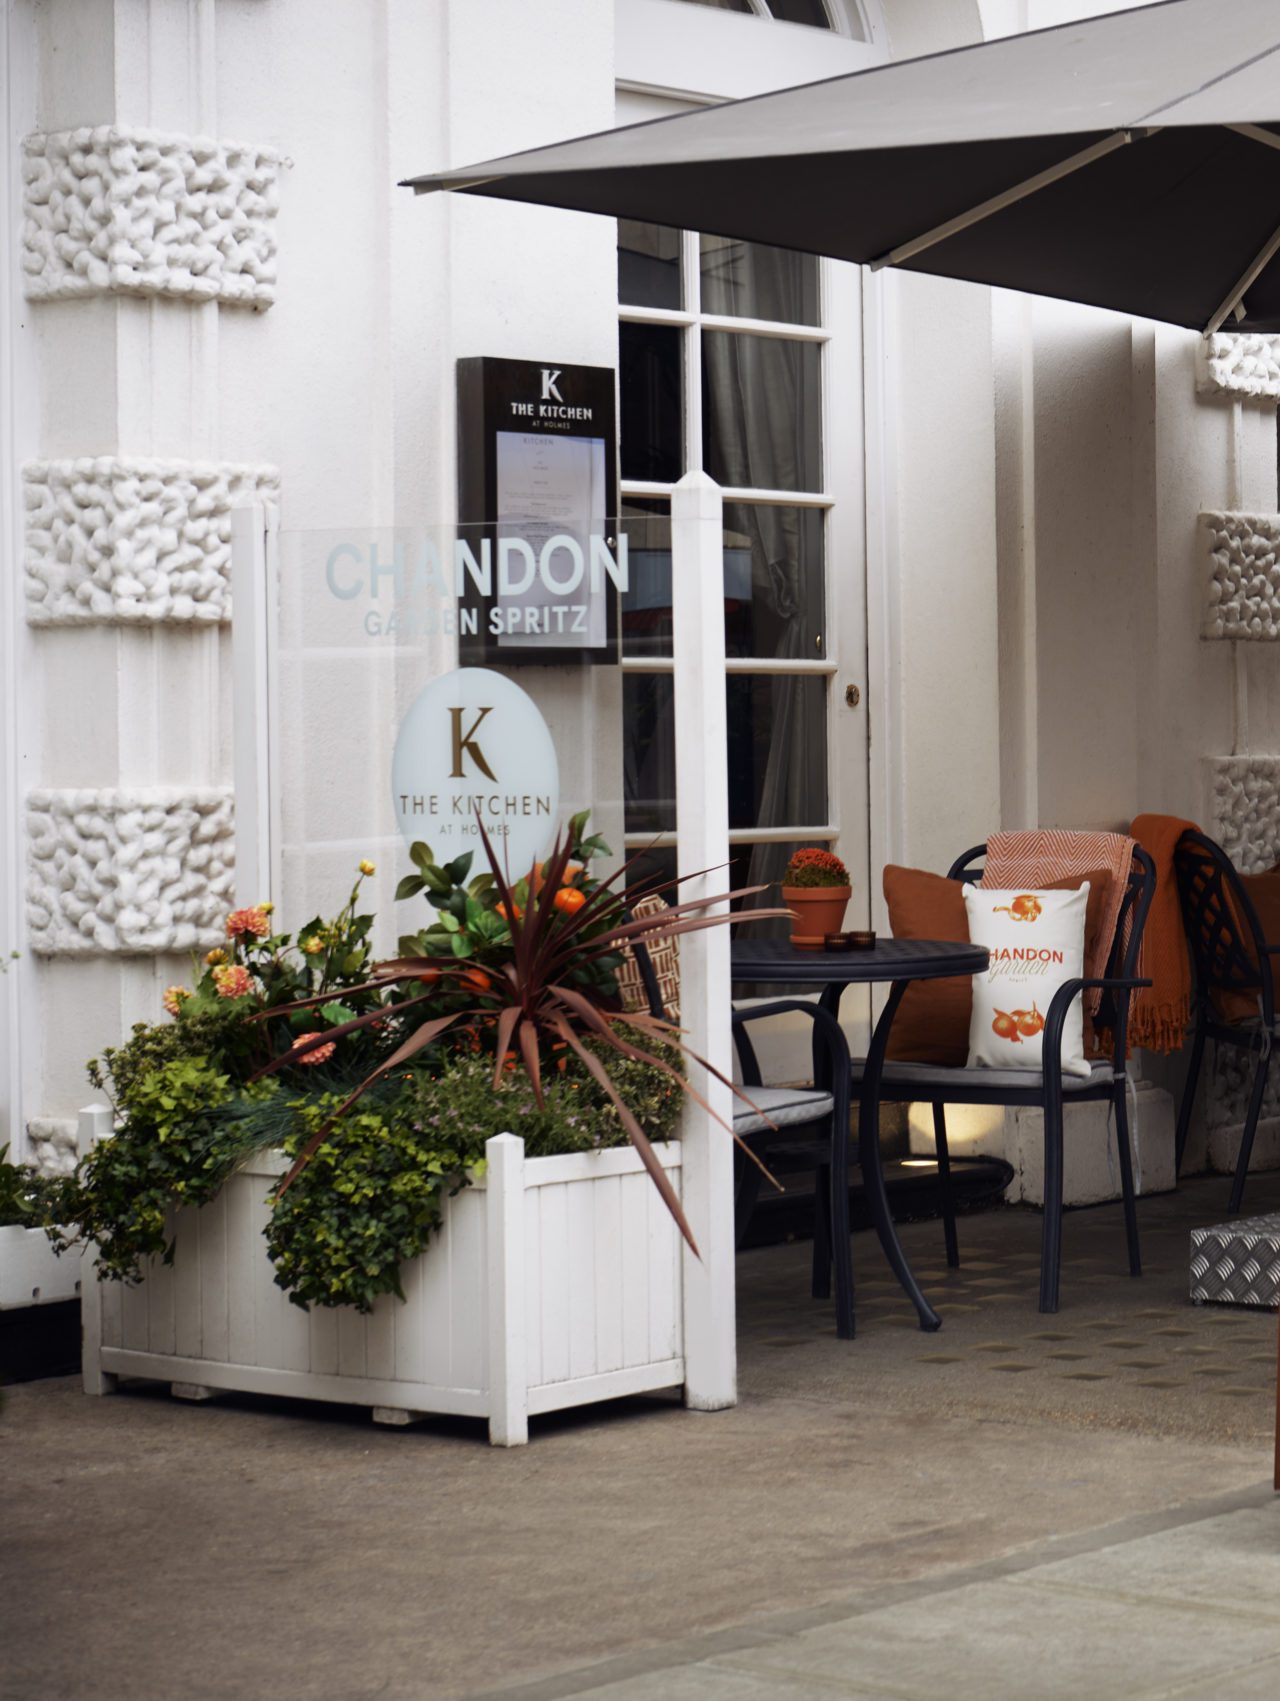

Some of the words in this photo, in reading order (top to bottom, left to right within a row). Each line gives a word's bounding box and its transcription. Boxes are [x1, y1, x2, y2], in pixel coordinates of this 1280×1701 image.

[541, 369, 563, 402] K
[511, 402, 534, 416] THE
[540, 405, 593, 420] KITCHEN
[544, 421, 571, 430] HOLMES
[325, 533, 630, 601] CHANDON
[363, 608, 479, 638] GARDEN
[488, 604, 588, 636] SPRITZ
[447, 707, 499, 784] K
[400, 795, 439, 815] THE
[452, 795, 551, 816] KITCHEN
[440, 824, 453, 835] AT
[461, 824, 511, 836] HOMES
[988, 947, 1064, 964] HANDON
